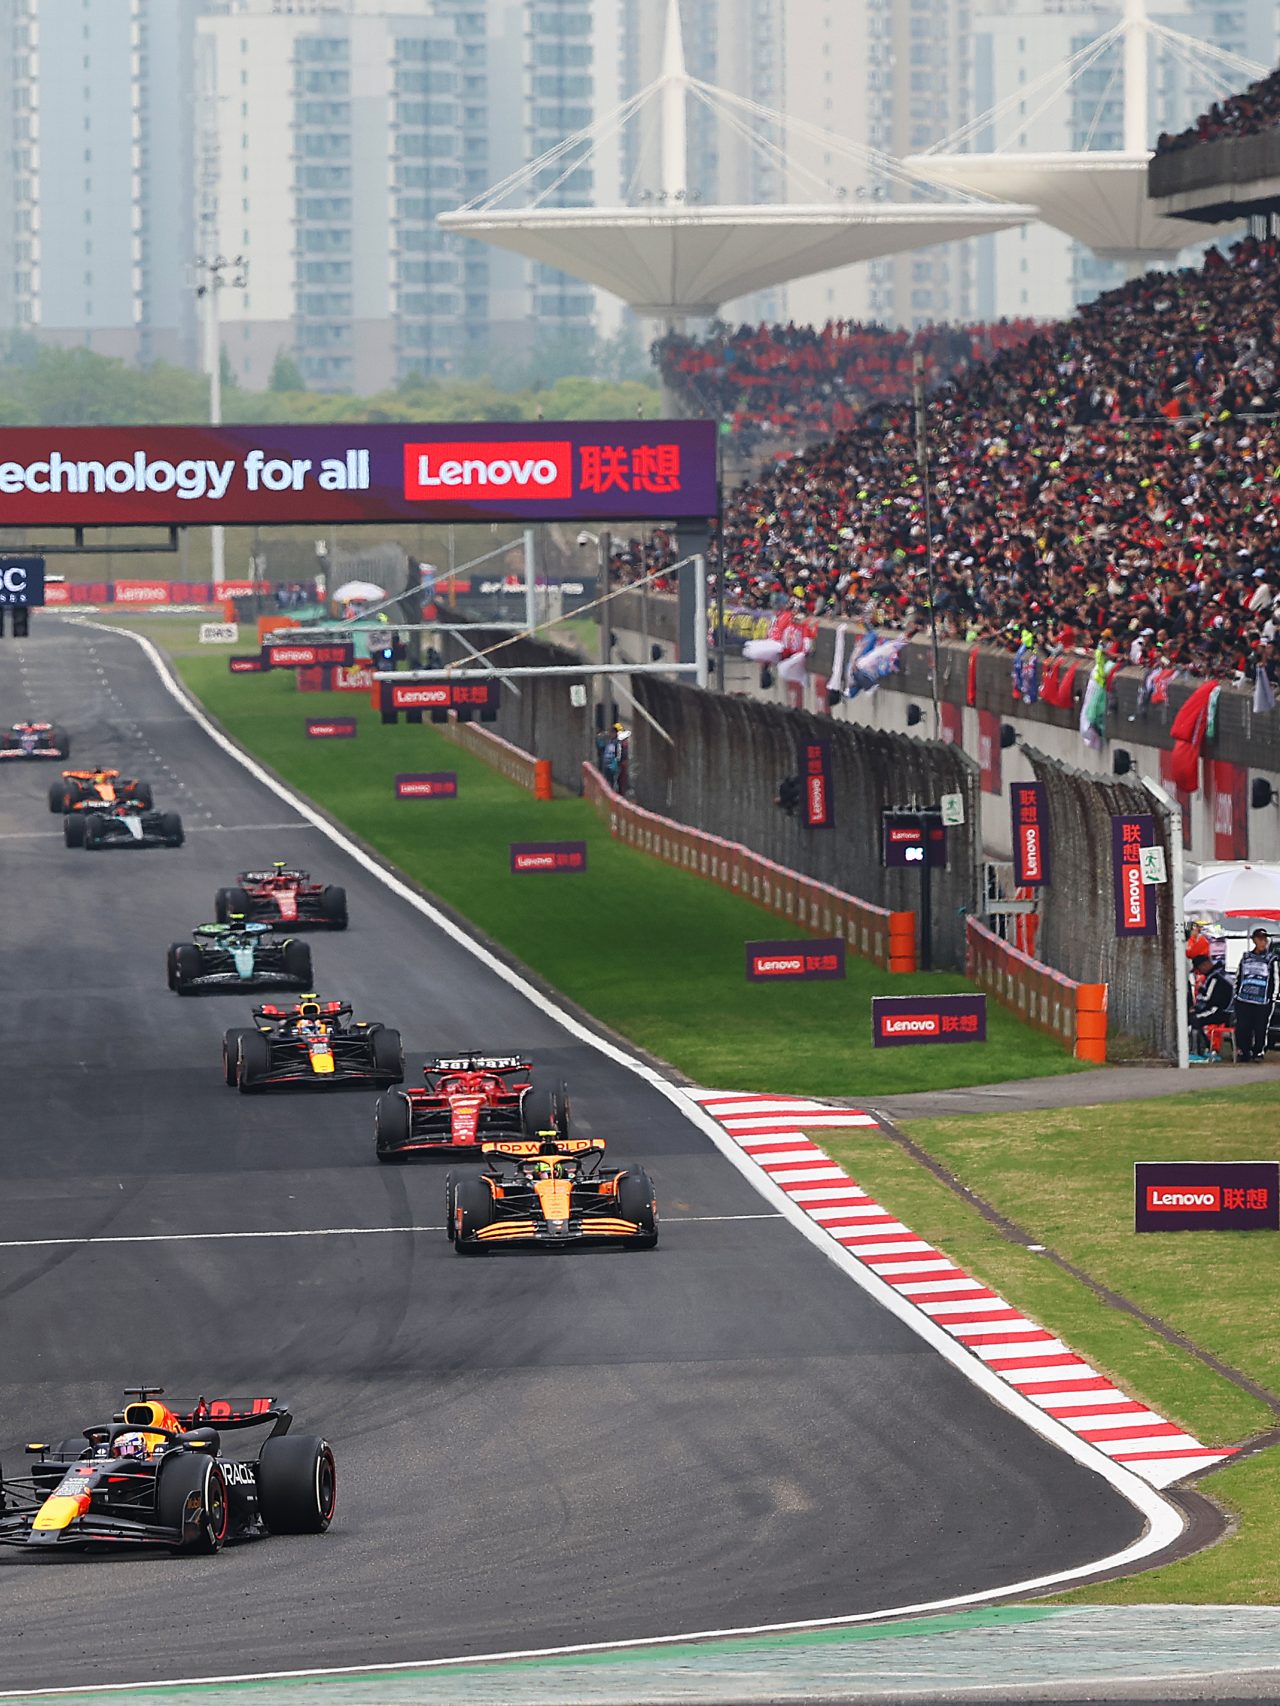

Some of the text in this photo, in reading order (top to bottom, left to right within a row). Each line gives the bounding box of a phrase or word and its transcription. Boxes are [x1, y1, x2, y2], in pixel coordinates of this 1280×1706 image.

[244, 449, 312, 491] for
[318, 449, 370, 490] all
[418, 444, 682, 493] Lenovo 联想
[397, 689, 447, 703] Lenovo
[1019, 789, 1037, 823] 联想
[1025, 829, 1038, 876] Lenovo
[1122, 824, 1142, 862] 联想
[1128, 869, 1141, 923] Lenovo
[757, 959, 801, 972] Lenovo
[886, 1019, 935, 1032] Lenovo
[500, 1142, 589, 1153] DP WRLD
[1152, 1188, 1268, 1210] Lenovo 联想
